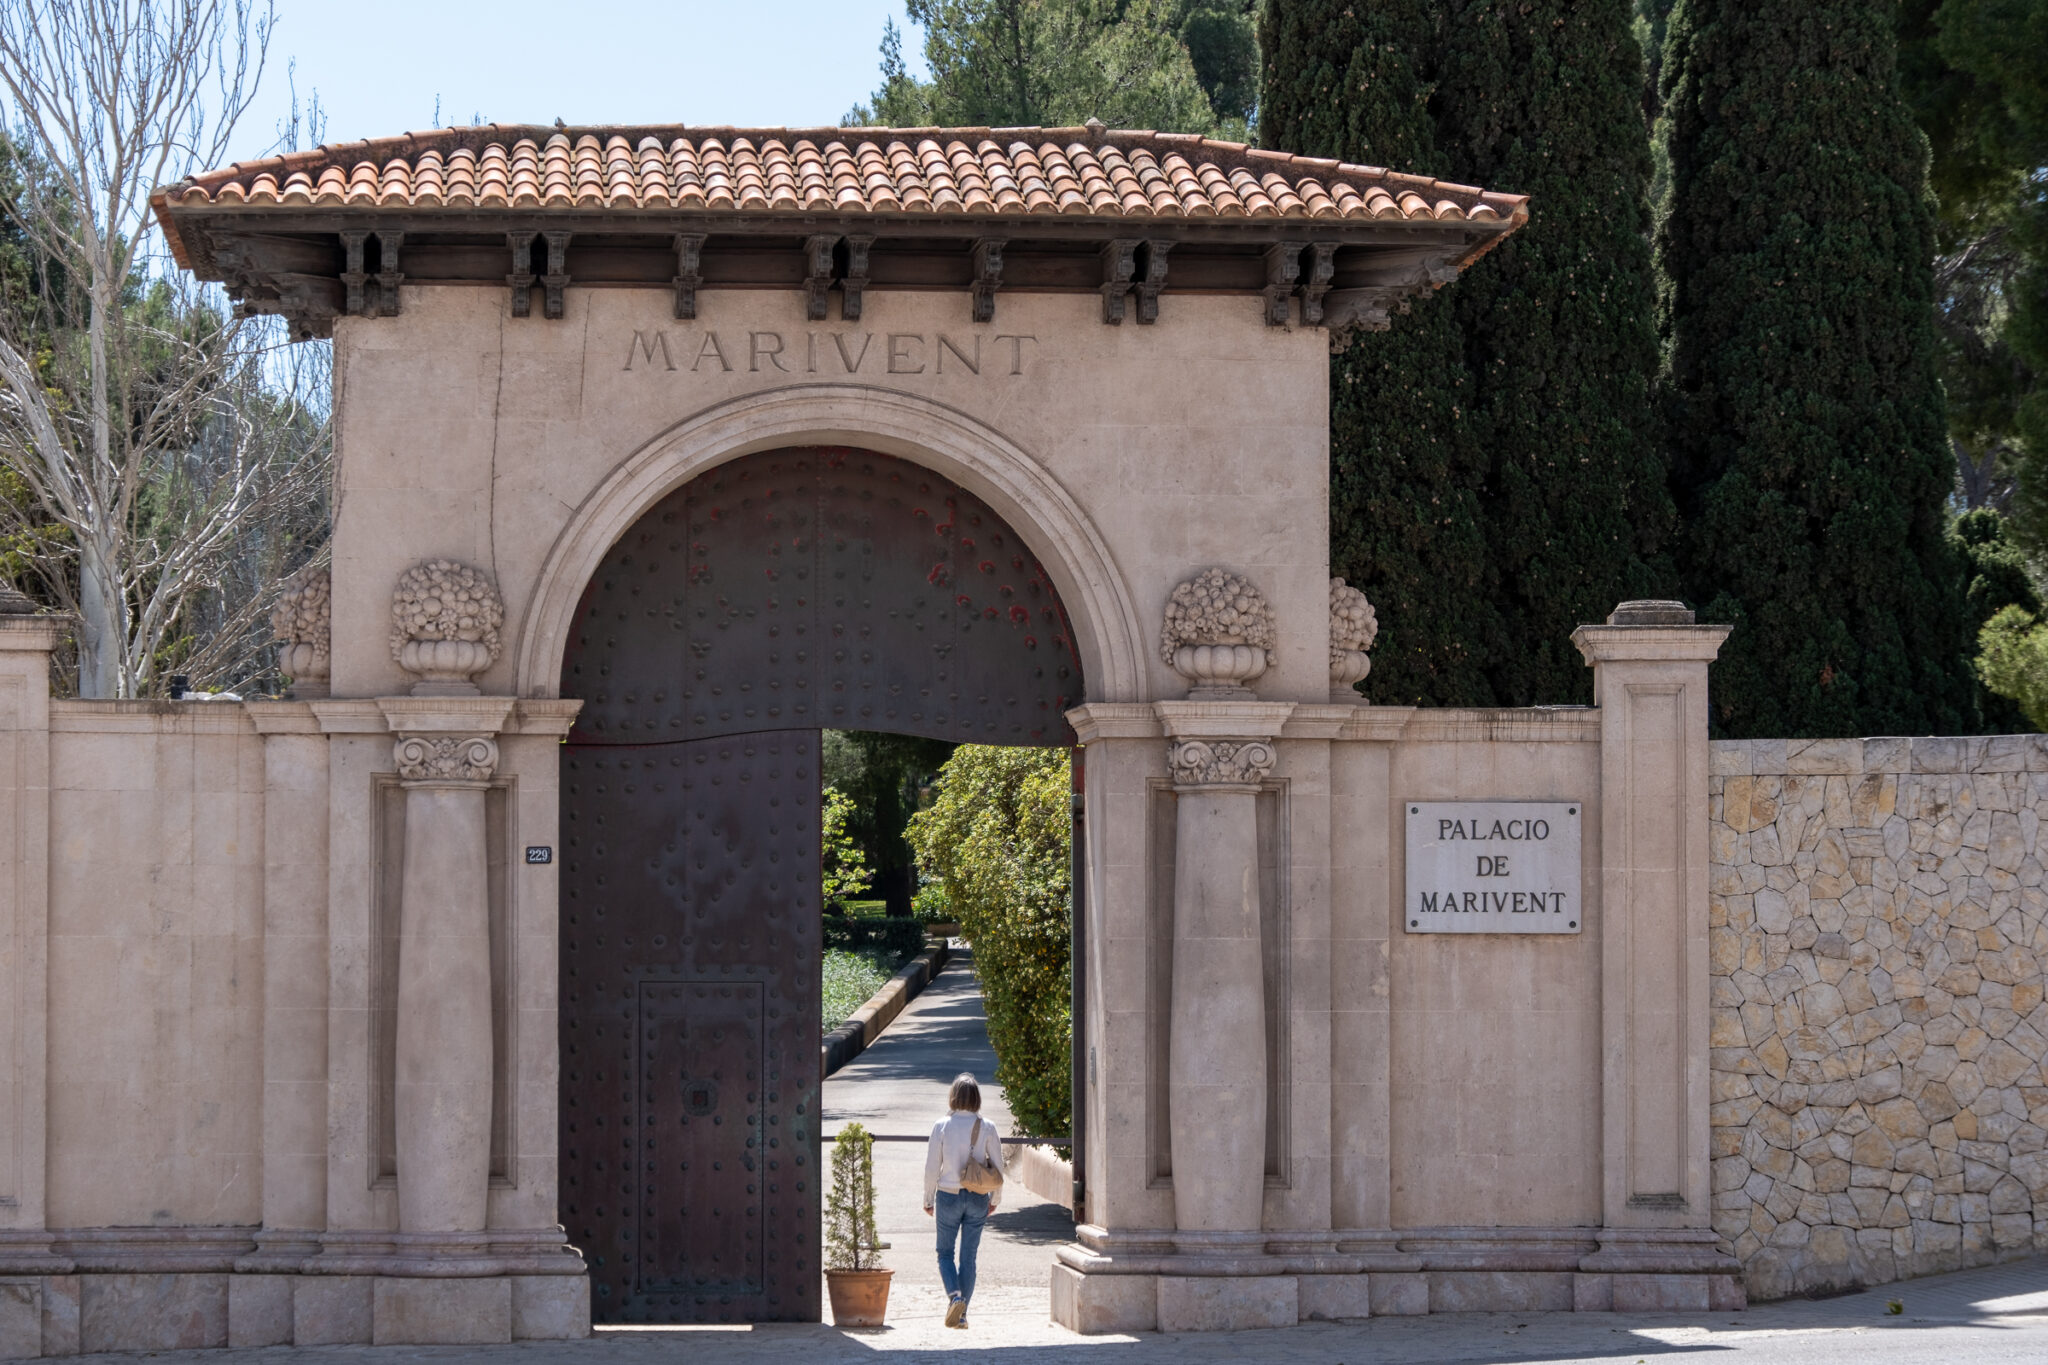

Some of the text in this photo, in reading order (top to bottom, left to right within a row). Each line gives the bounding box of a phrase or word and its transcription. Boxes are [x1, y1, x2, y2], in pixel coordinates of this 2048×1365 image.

[622, 329, 1039, 375] MARIVENT
[1438, 819, 1550, 841] PALACIO
[529, 849, 548, 861] 229
[1476, 855, 1510, 877] DE
[1420, 891, 1566, 913] MARIVENT
